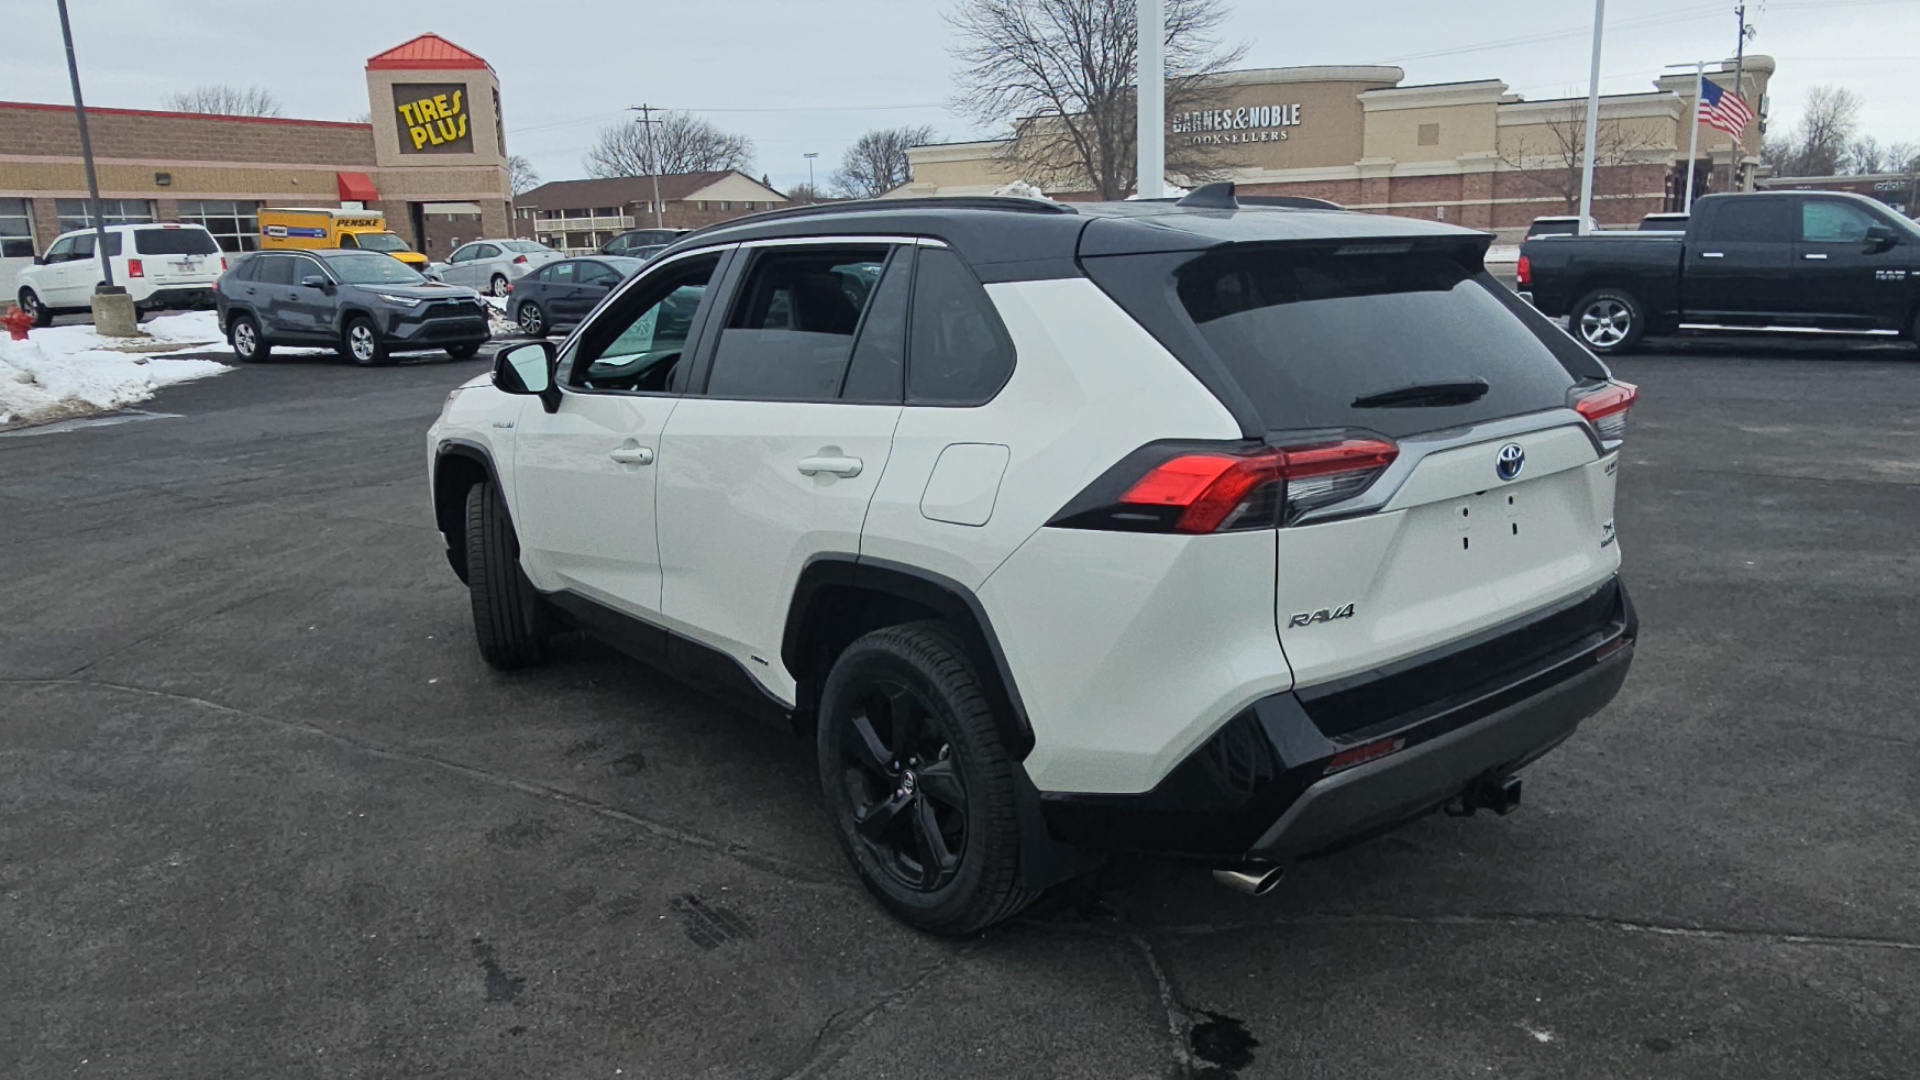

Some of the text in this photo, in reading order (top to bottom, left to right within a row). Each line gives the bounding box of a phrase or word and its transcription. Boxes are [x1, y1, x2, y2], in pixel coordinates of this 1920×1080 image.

[398, 89, 462, 127] TIRES
[410, 113, 467, 150] PLUS
[336, 219, 379, 227] PENSKE
[1288, 602, 1355, 628] RAV4
